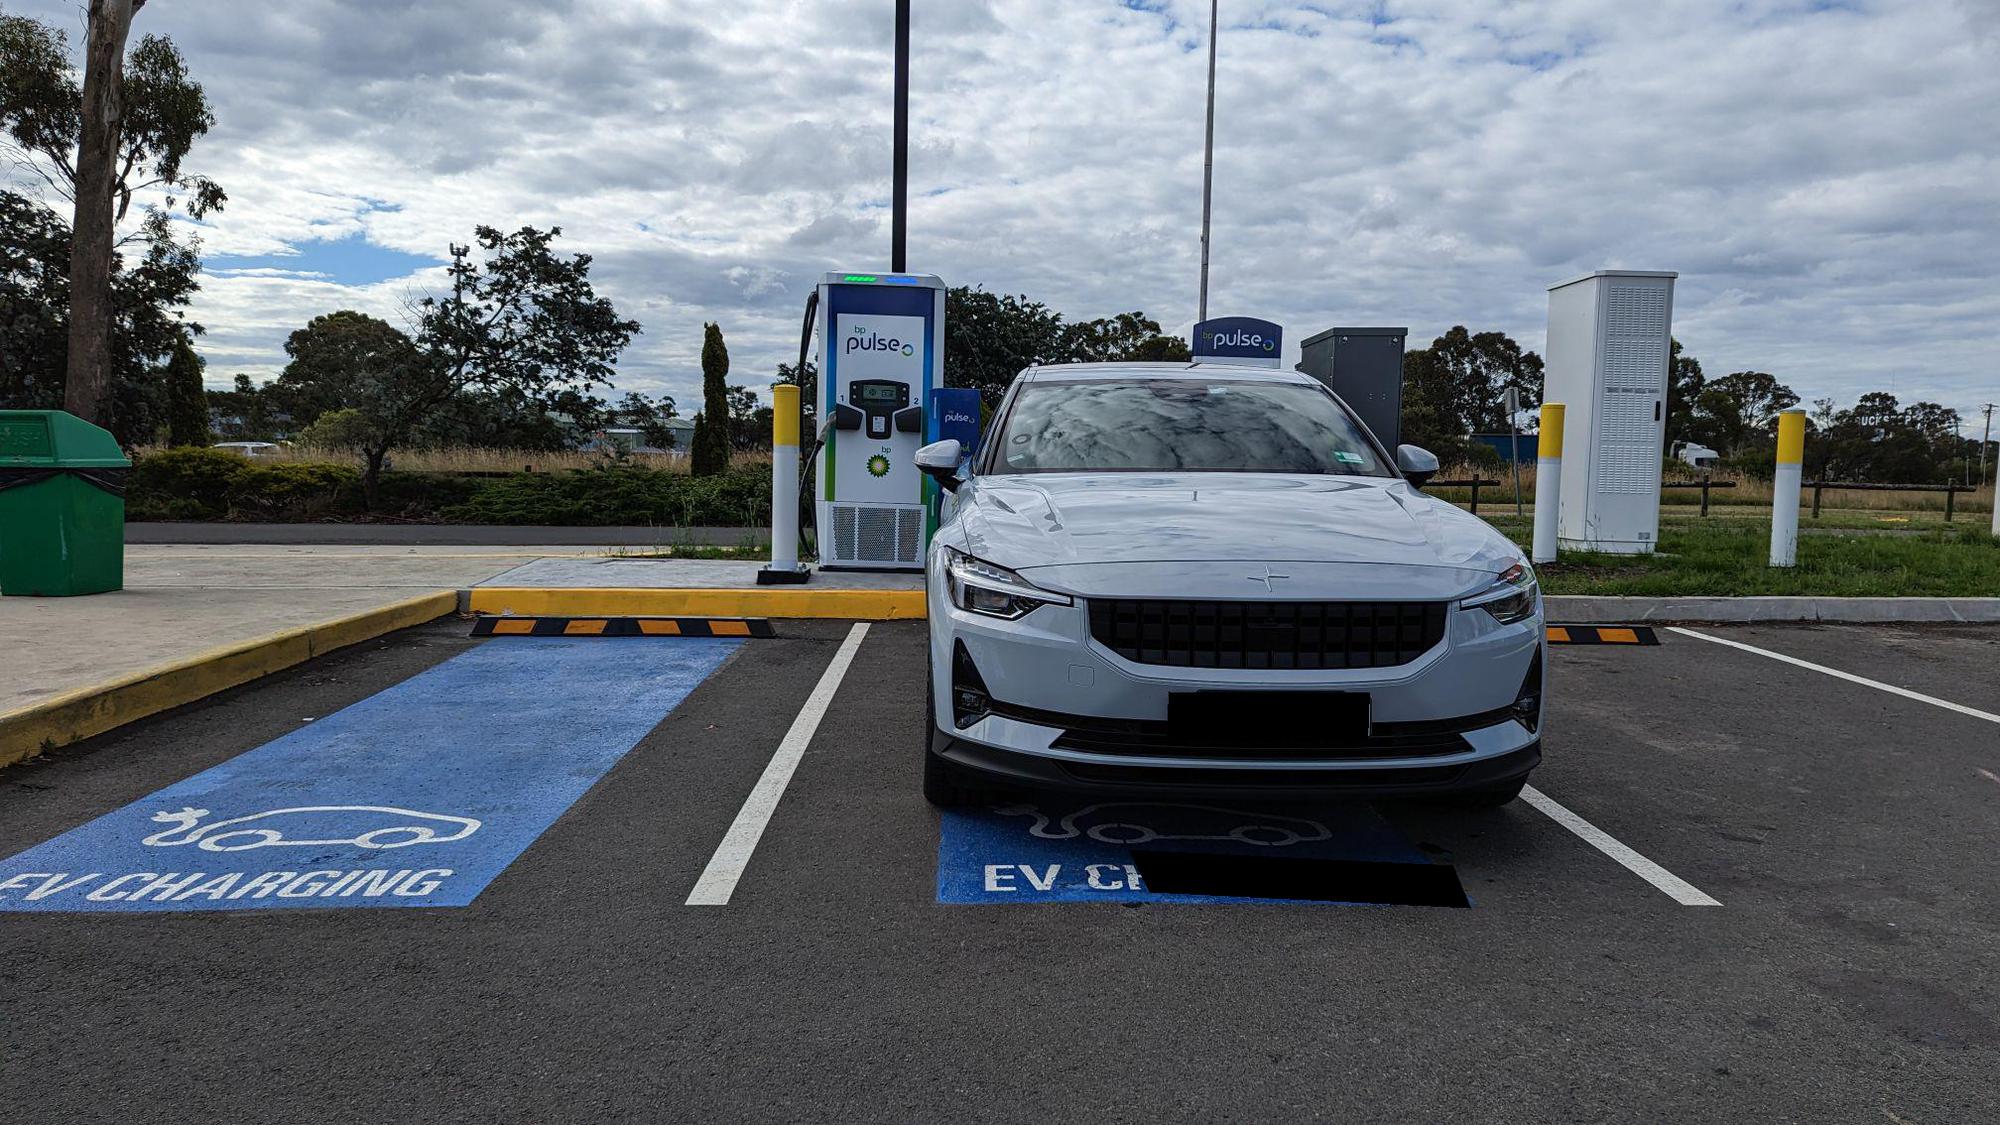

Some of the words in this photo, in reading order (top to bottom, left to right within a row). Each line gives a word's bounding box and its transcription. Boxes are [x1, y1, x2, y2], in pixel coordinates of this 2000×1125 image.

[854, 325, 866, 336] bp
[846, 332, 900, 355] pulse
[1213, 328, 1262, 350] pulse
[913, 397, 920, 405] 2
[944, 412, 969, 423] pulse
[881, 445, 892, 454] bp
[86, 868, 454, 901] CHARGING
[984, 864, 1062, 892] EV
